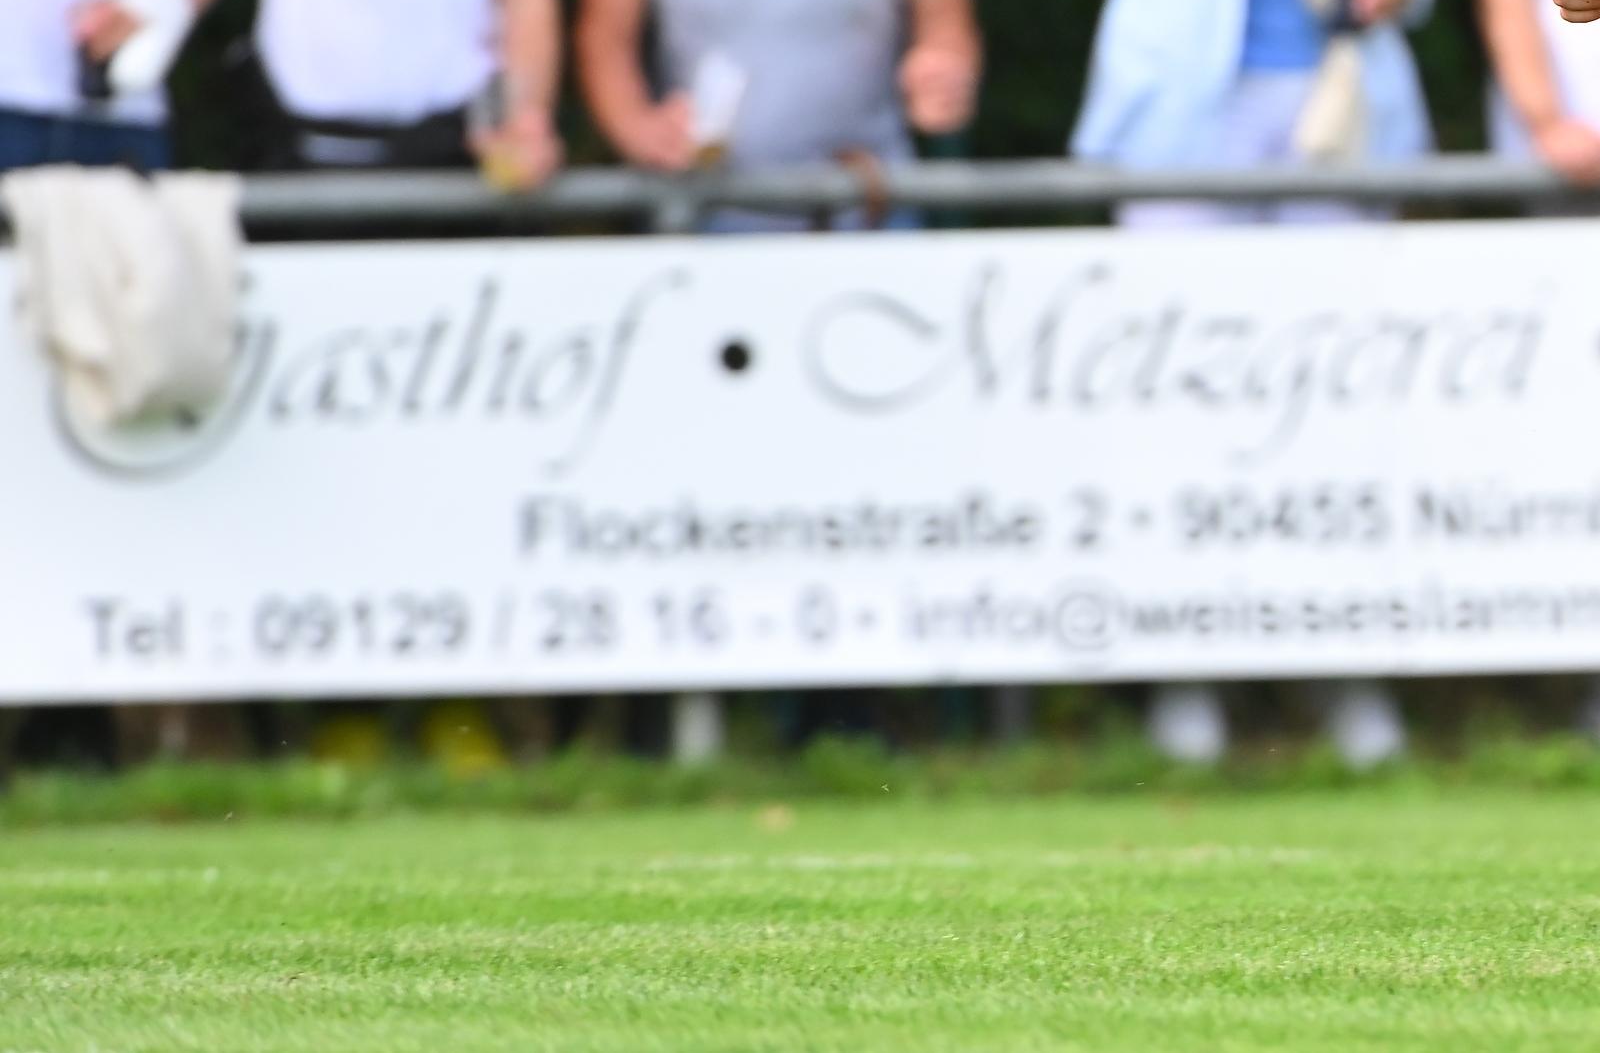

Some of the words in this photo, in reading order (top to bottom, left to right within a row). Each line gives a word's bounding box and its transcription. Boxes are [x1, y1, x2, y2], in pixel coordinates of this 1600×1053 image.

[515, 487, 1043, 560] Flockenstraße
[1068, 486, 1108, 553] 2
[1173, 481, 1392, 549] 90455
[250, 590, 473, 664] 09129
[536, 588, 619, 655] 28
[646, 584, 729, 650] 16
[793, 580, 840, 649] 0
